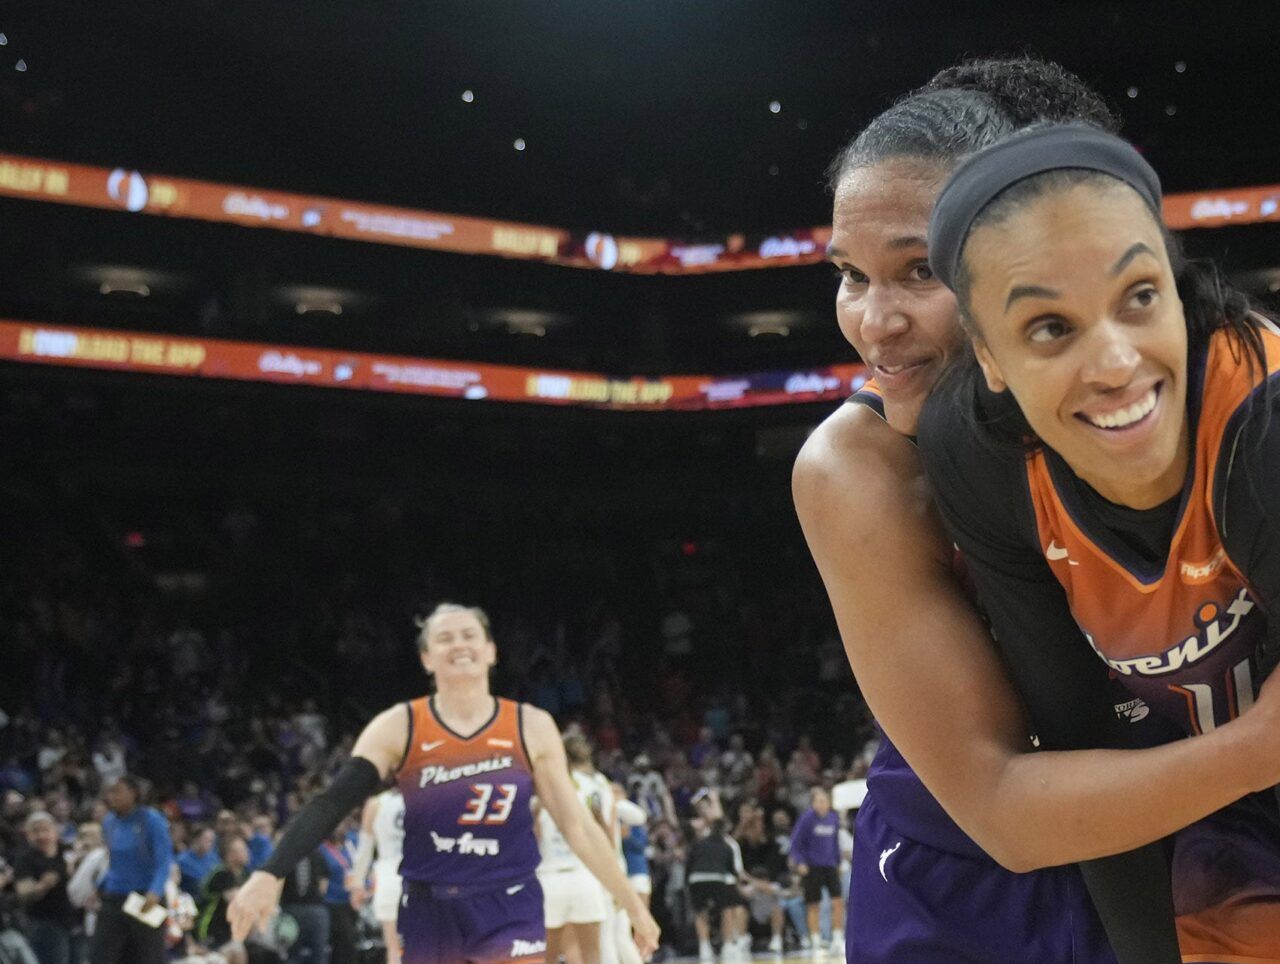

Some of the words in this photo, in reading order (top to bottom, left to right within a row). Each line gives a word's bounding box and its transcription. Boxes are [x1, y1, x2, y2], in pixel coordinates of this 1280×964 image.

[1084, 587, 1256, 676] oenix
[419, 755, 513, 788] Phoenix
[457, 783, 518, 825] 33
